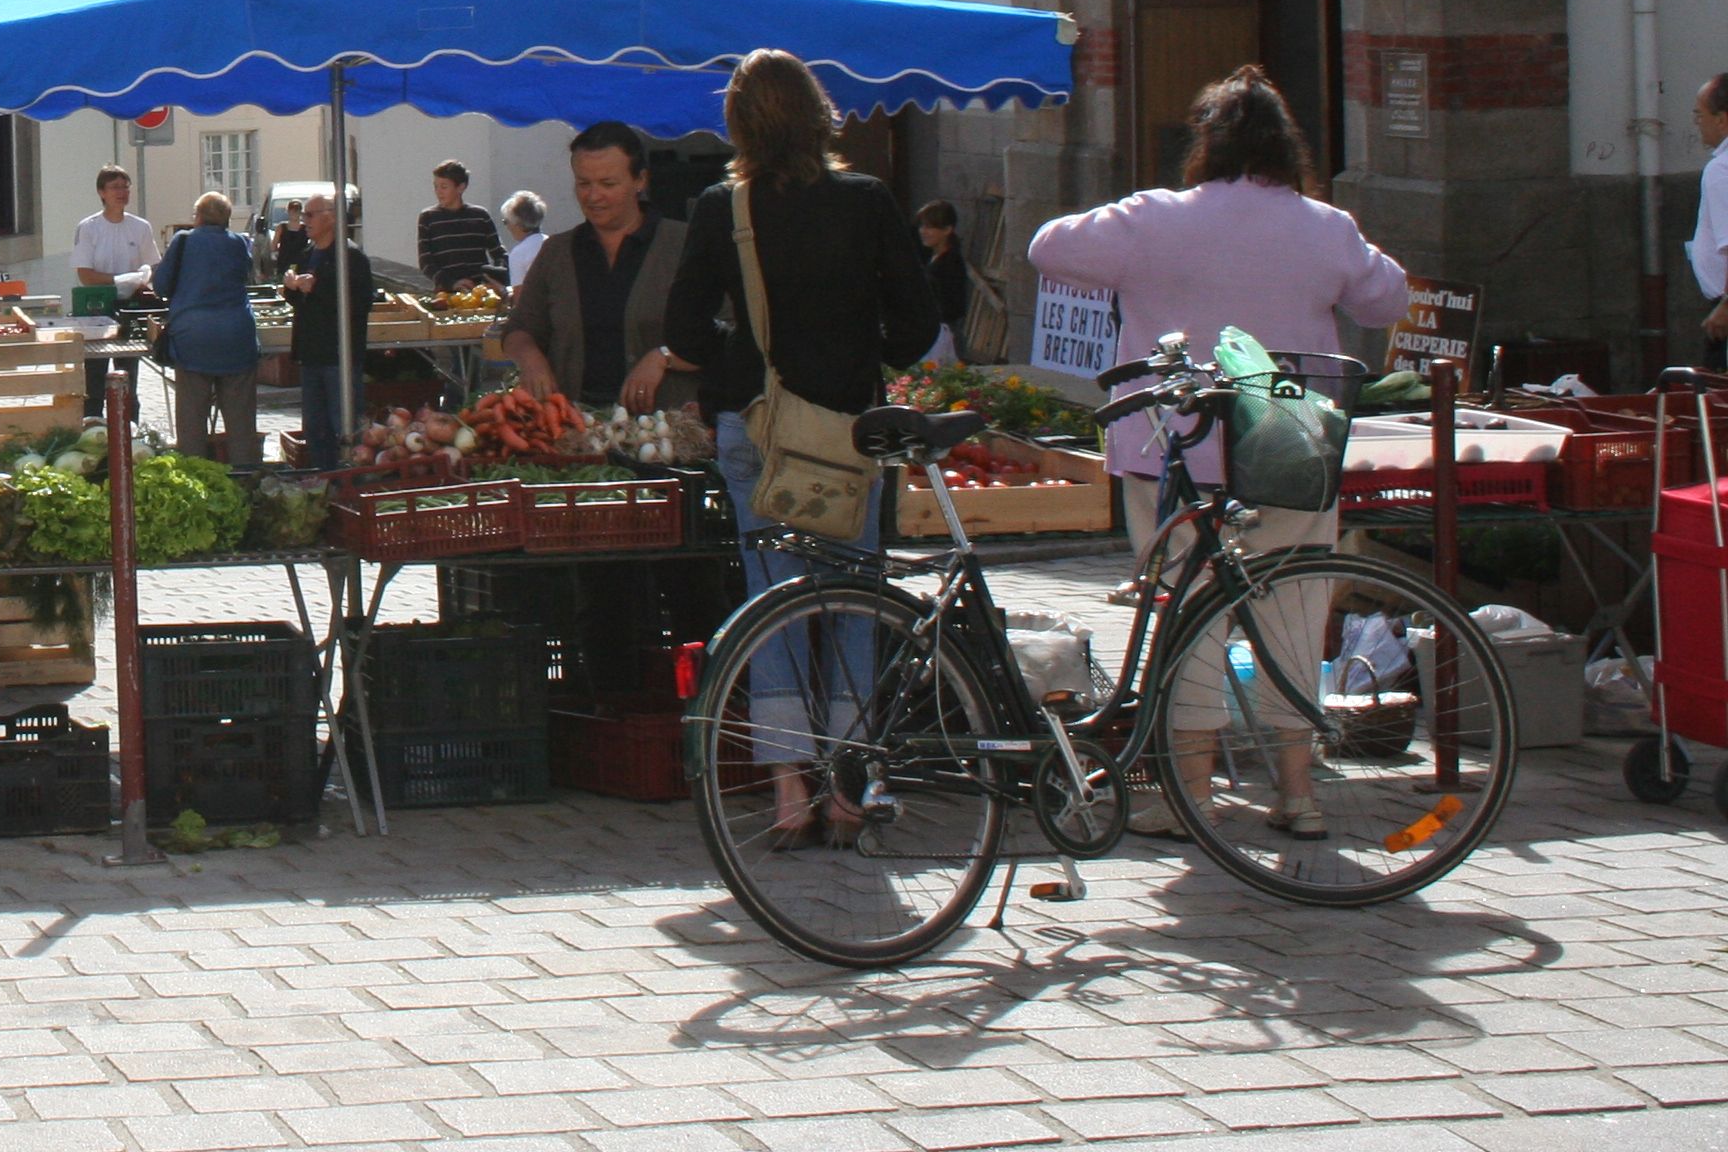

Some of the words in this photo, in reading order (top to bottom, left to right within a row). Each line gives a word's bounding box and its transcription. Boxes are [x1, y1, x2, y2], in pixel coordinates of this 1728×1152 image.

[1041, 301, 1064, 330] LES
[1417, 310, 1438, 329] LA
[1043, 334, 1104, 371] BRETONS
[1393, 354, 1415, 371] des
